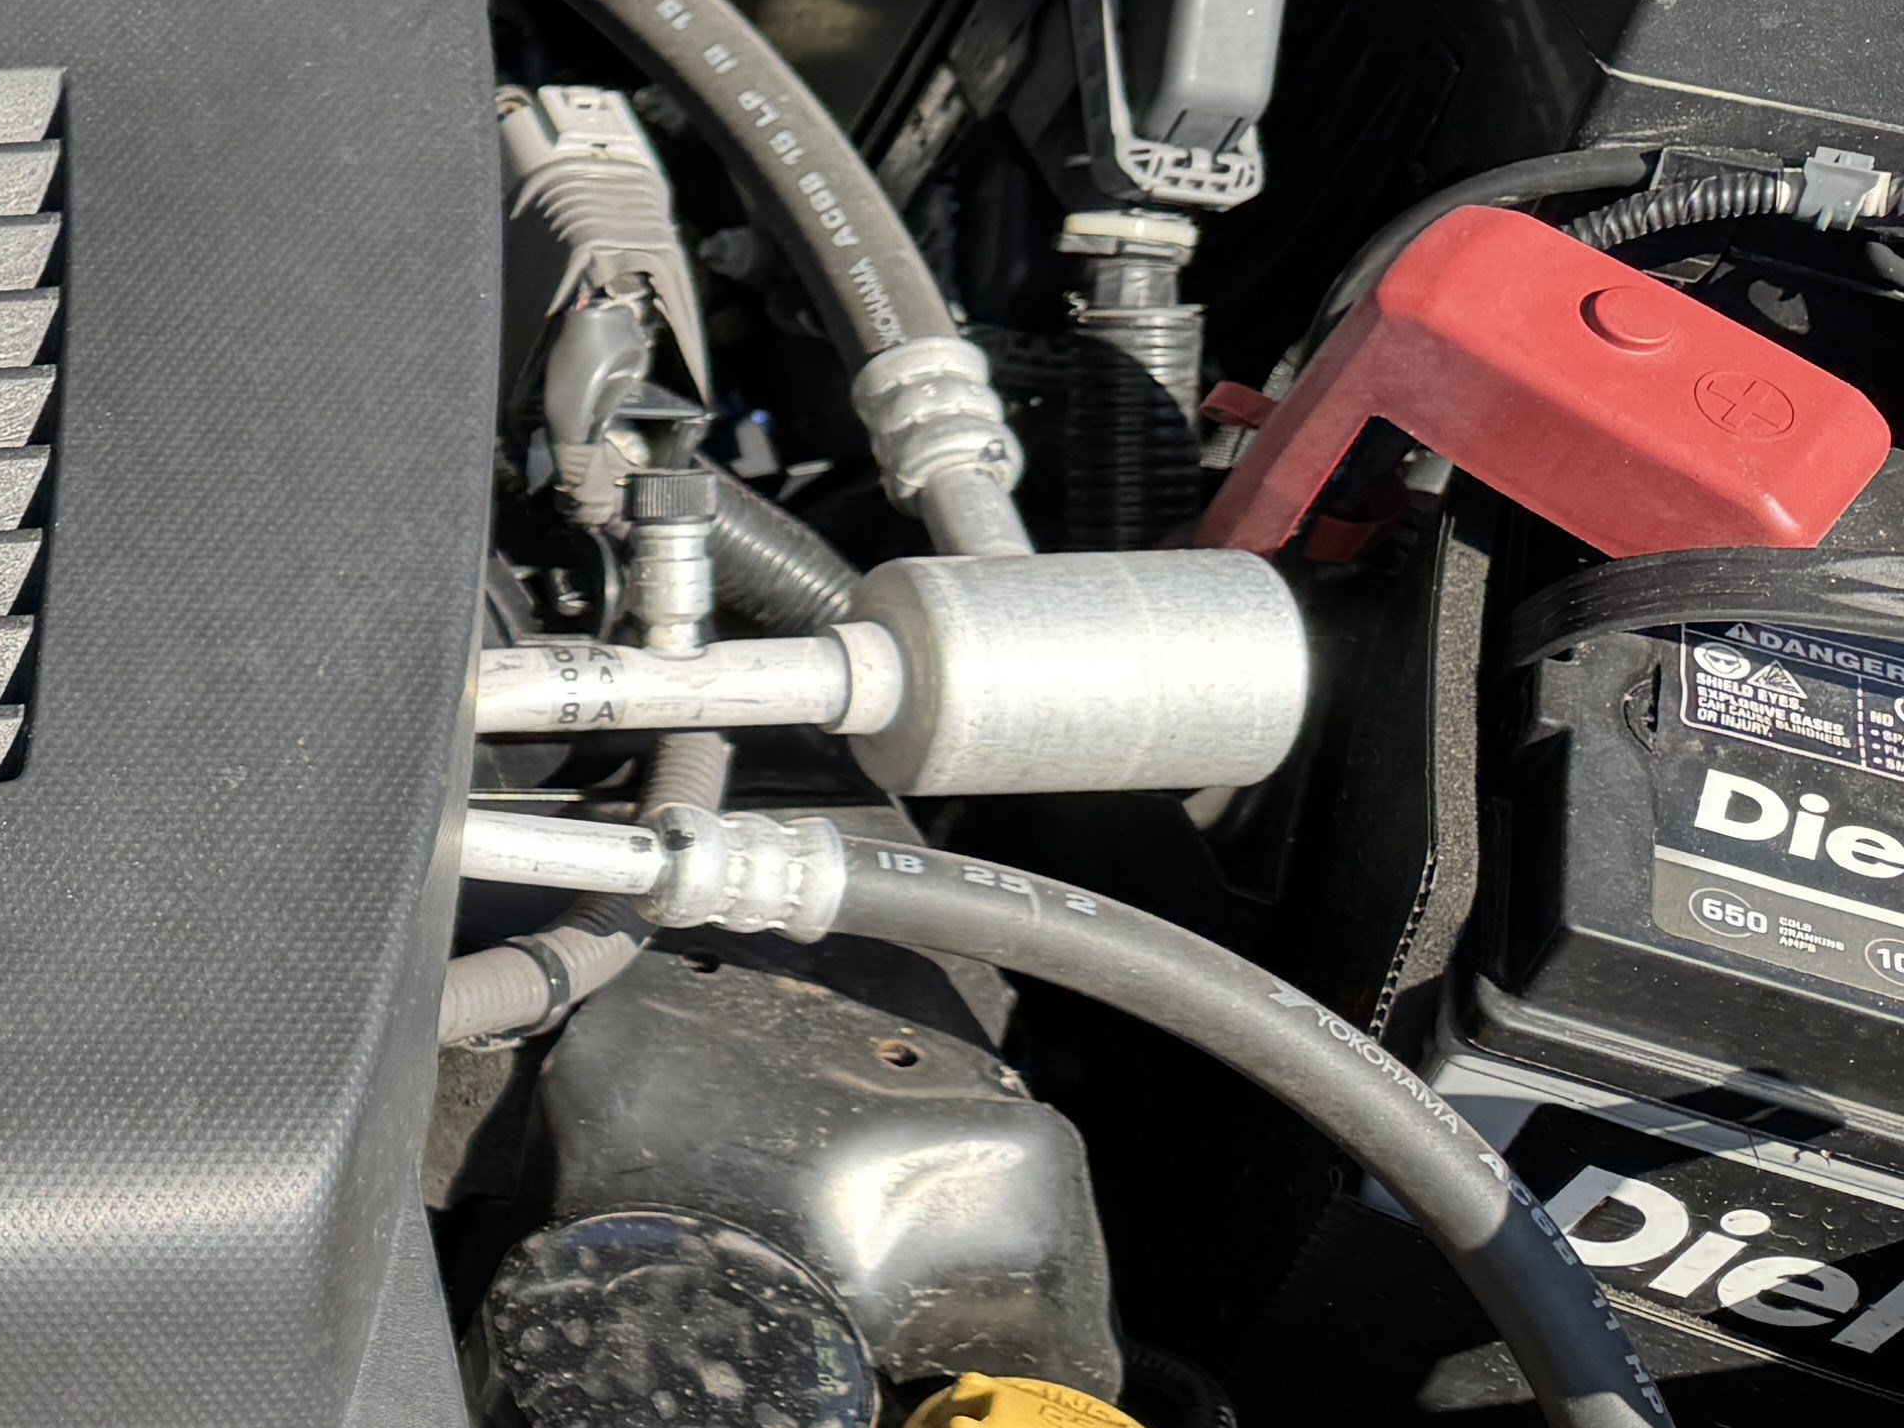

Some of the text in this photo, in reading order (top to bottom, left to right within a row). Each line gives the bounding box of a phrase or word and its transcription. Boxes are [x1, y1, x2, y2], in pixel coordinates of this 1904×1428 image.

[1696, 672, 1754, 698] SHIELD
[1697, 686, 1845, 736] EXPLOSIVE GASES
[1702, 898, 1768, 934] 650
[1316, 1006, 1460, 1135] YOKOHAMA
[1624, 1354, 1665, 1414] HP
